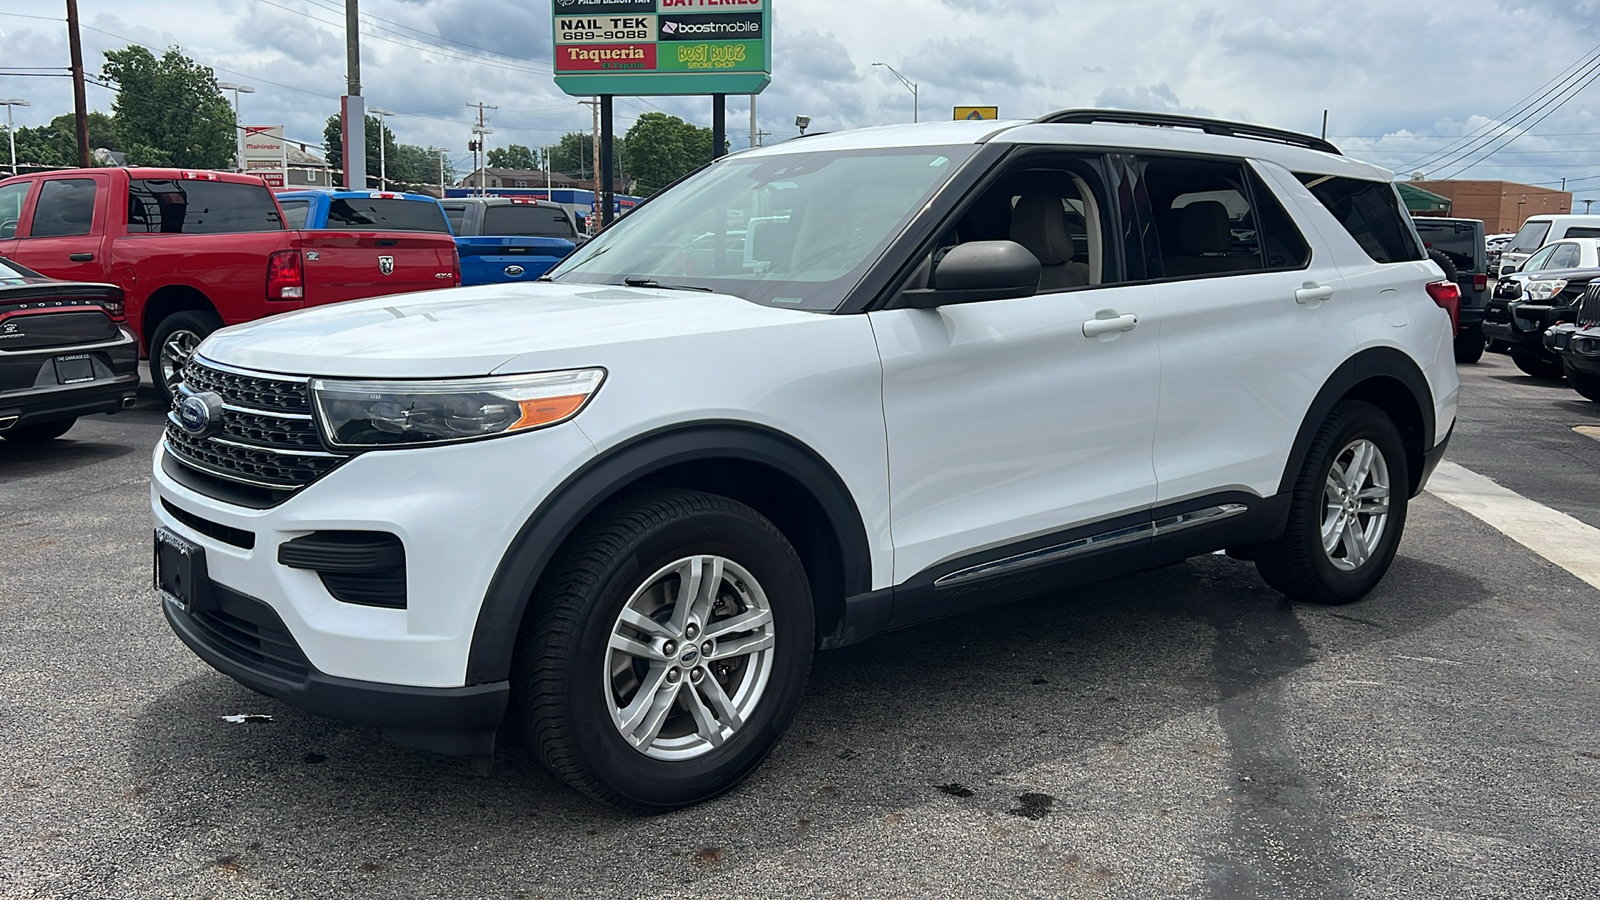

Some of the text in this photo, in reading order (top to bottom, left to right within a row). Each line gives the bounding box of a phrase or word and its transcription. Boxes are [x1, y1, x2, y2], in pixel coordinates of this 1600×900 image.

[561, 18, 648, 30] NAIL TEK
[563, 30, 647, 40] 689-9088
[687, 61, 735, 69] SMOKE SHOP
